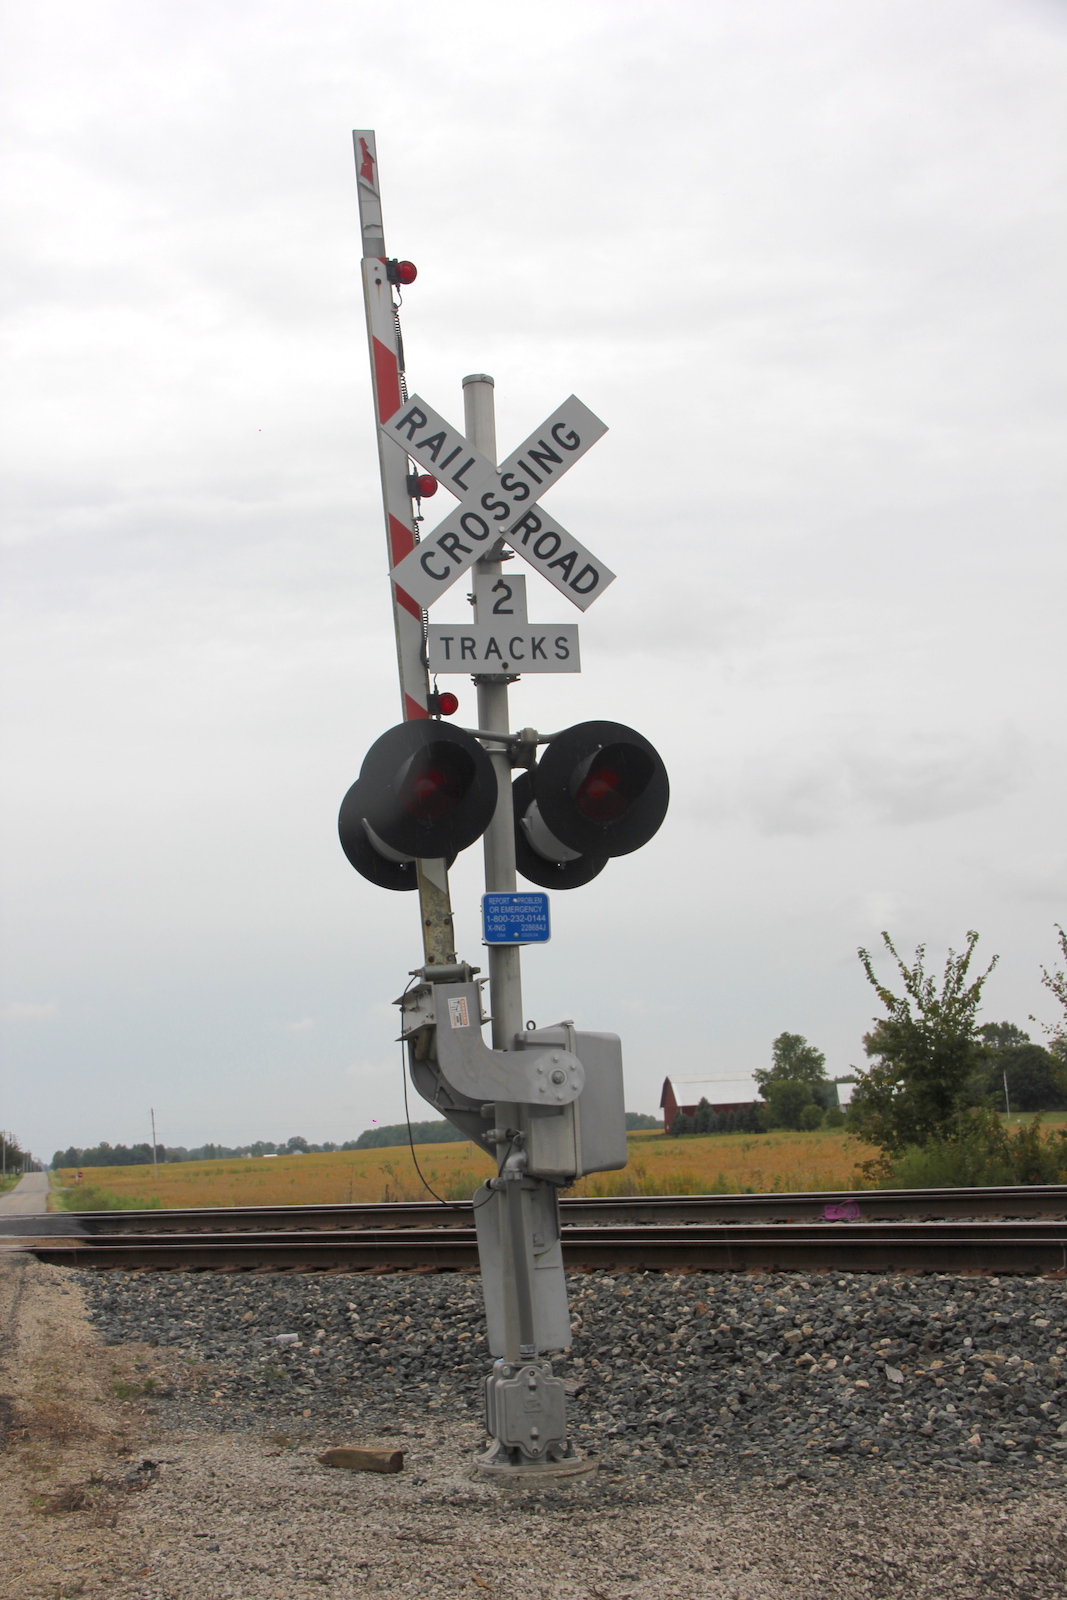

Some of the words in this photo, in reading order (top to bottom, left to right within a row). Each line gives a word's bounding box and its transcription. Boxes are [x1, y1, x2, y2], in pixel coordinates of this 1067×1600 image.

[395, 406, 475, 491] RAIL
[510, 510, 599, 594] ROAD
[420, 422, 581, 581] CROSSING
[492, 581, 514, 615] 2
[440, 636, 569, 660] TRACKS
[486, 914, 546, 922] 1-800-232-0144
[500, 905, 542, 913] EMERGENCY
